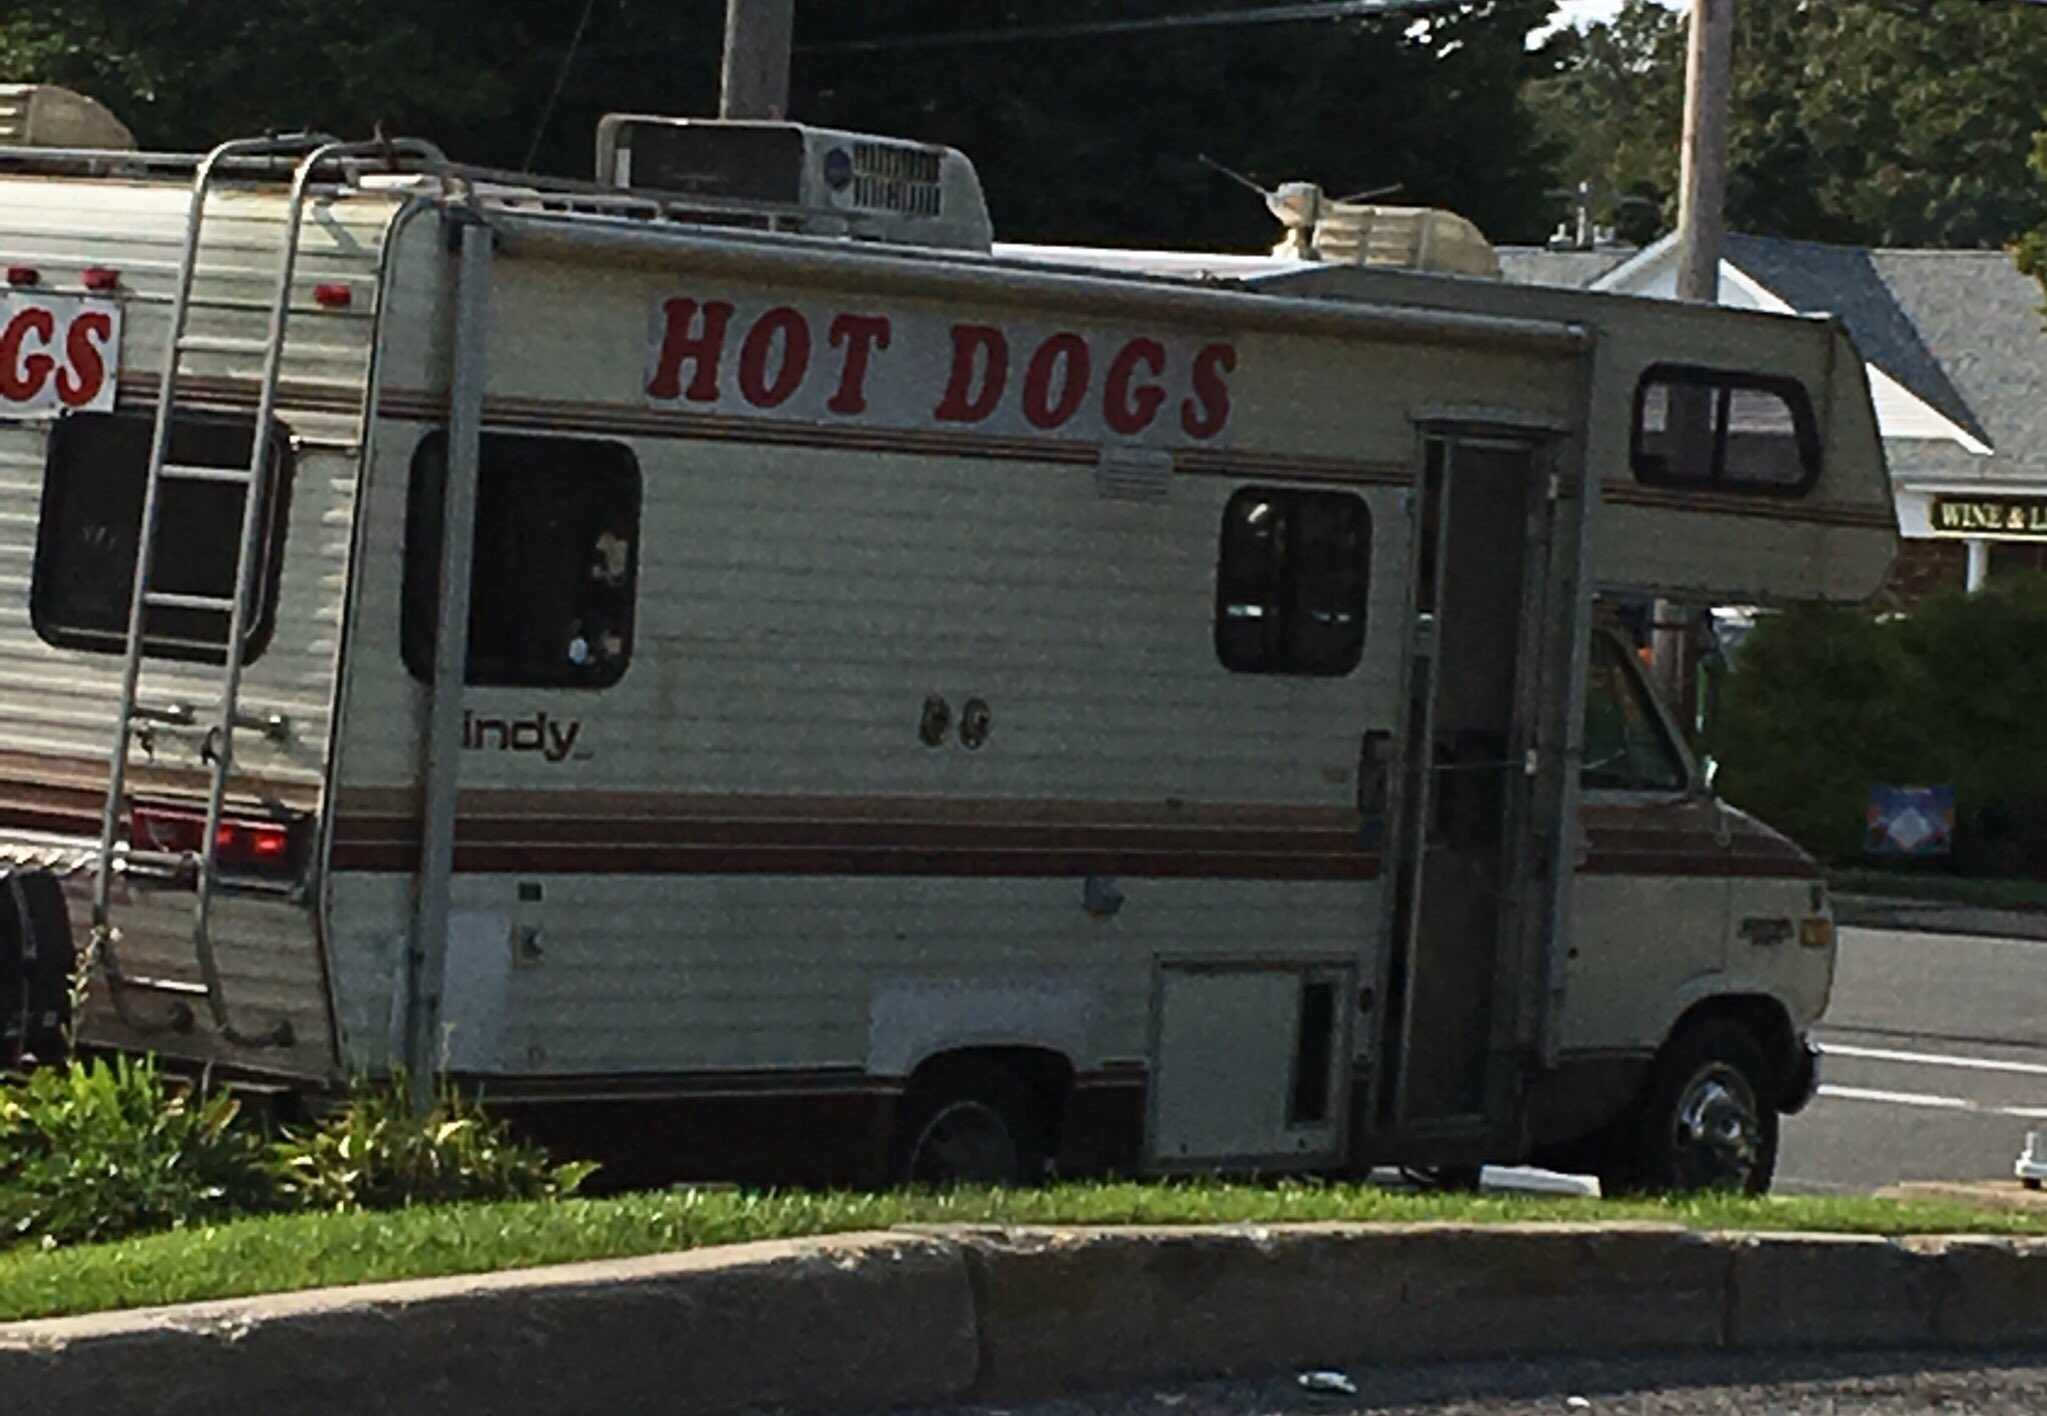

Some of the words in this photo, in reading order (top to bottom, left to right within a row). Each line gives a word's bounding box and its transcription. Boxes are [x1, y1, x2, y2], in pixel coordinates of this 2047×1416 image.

[647, 297, 891, 416] HOT
[932, 322, 1238, 439] DOGS
[1942, 502, 2003, 530] WINE
[2007, 506, 2025, 530] &
[462, 709, 581, 762] indy
